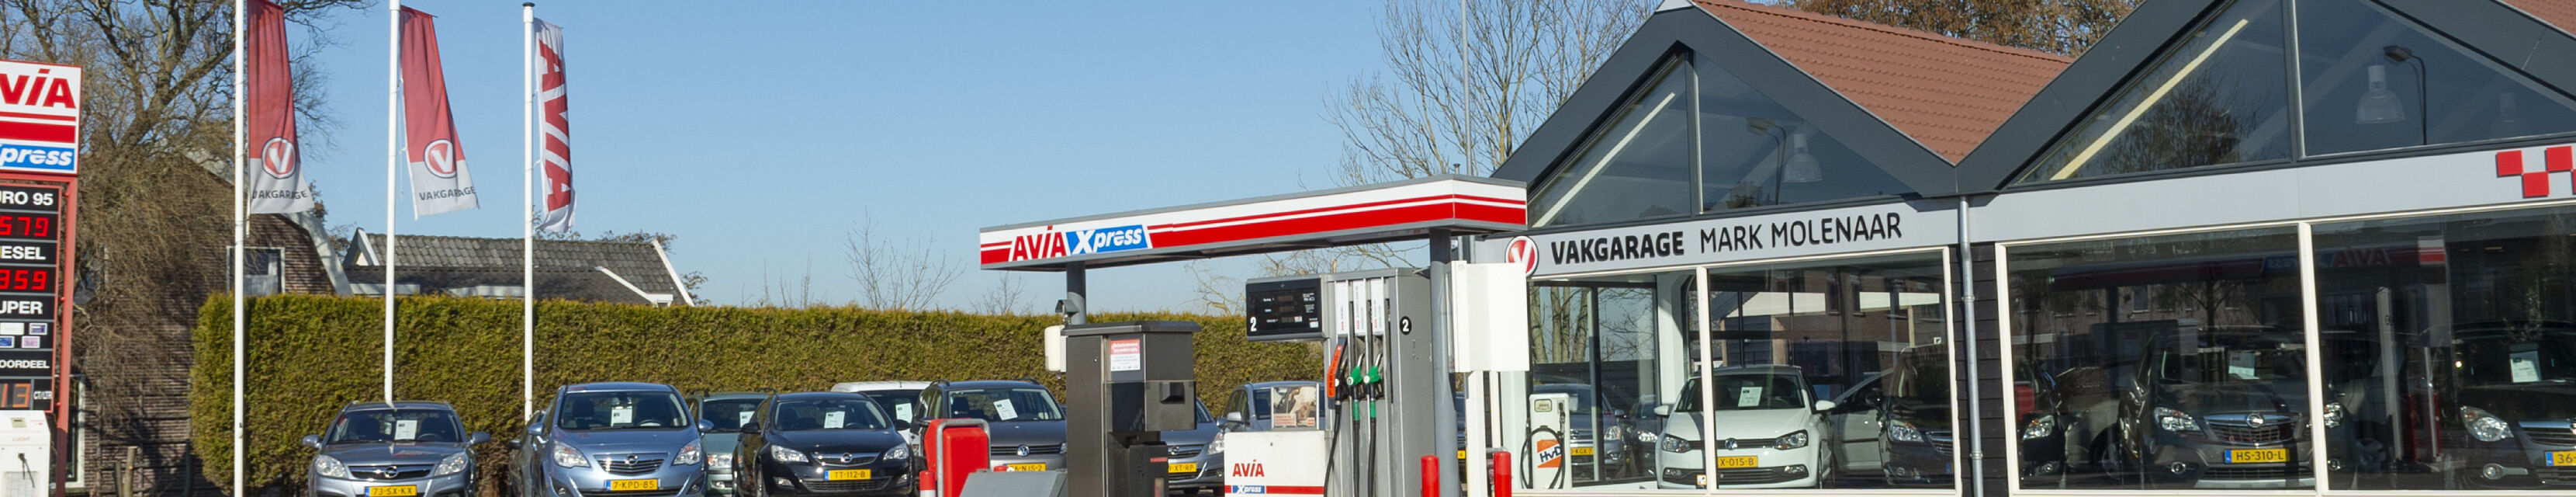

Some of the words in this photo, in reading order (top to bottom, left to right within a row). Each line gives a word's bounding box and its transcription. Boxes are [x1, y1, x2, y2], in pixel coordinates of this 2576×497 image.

[0, 68, 76, 109] VIA
[539, 40, 571, 212] AVIA
[0, 147, 73, 166] press
[0, 190, 29, 205] RO
[33, 193, 54, 206] 95
[1013, 225, 1067, 261] AVIA
[1071, 228, 1142, 255] Xpress
[1551, 231, 1684, 265] VAKGARAGE
[1701, 224, 1763, 253] MARK
[1771, 212, 1902, 248] MOLENAAR
[0, 245, 47, 260] ESEL
[0, 300, 43, 315] UPER
[1250, 316, 1257, 332] 2
[1402, 319, 1410, 332] 2
[0, 360, 50, 369] OORDEEL
[1719, 457, 1754, 466] X-015-B
[2236, 451, 2283, 461] HS-310-L
[1232, 459, 1265, 477] AVIA
